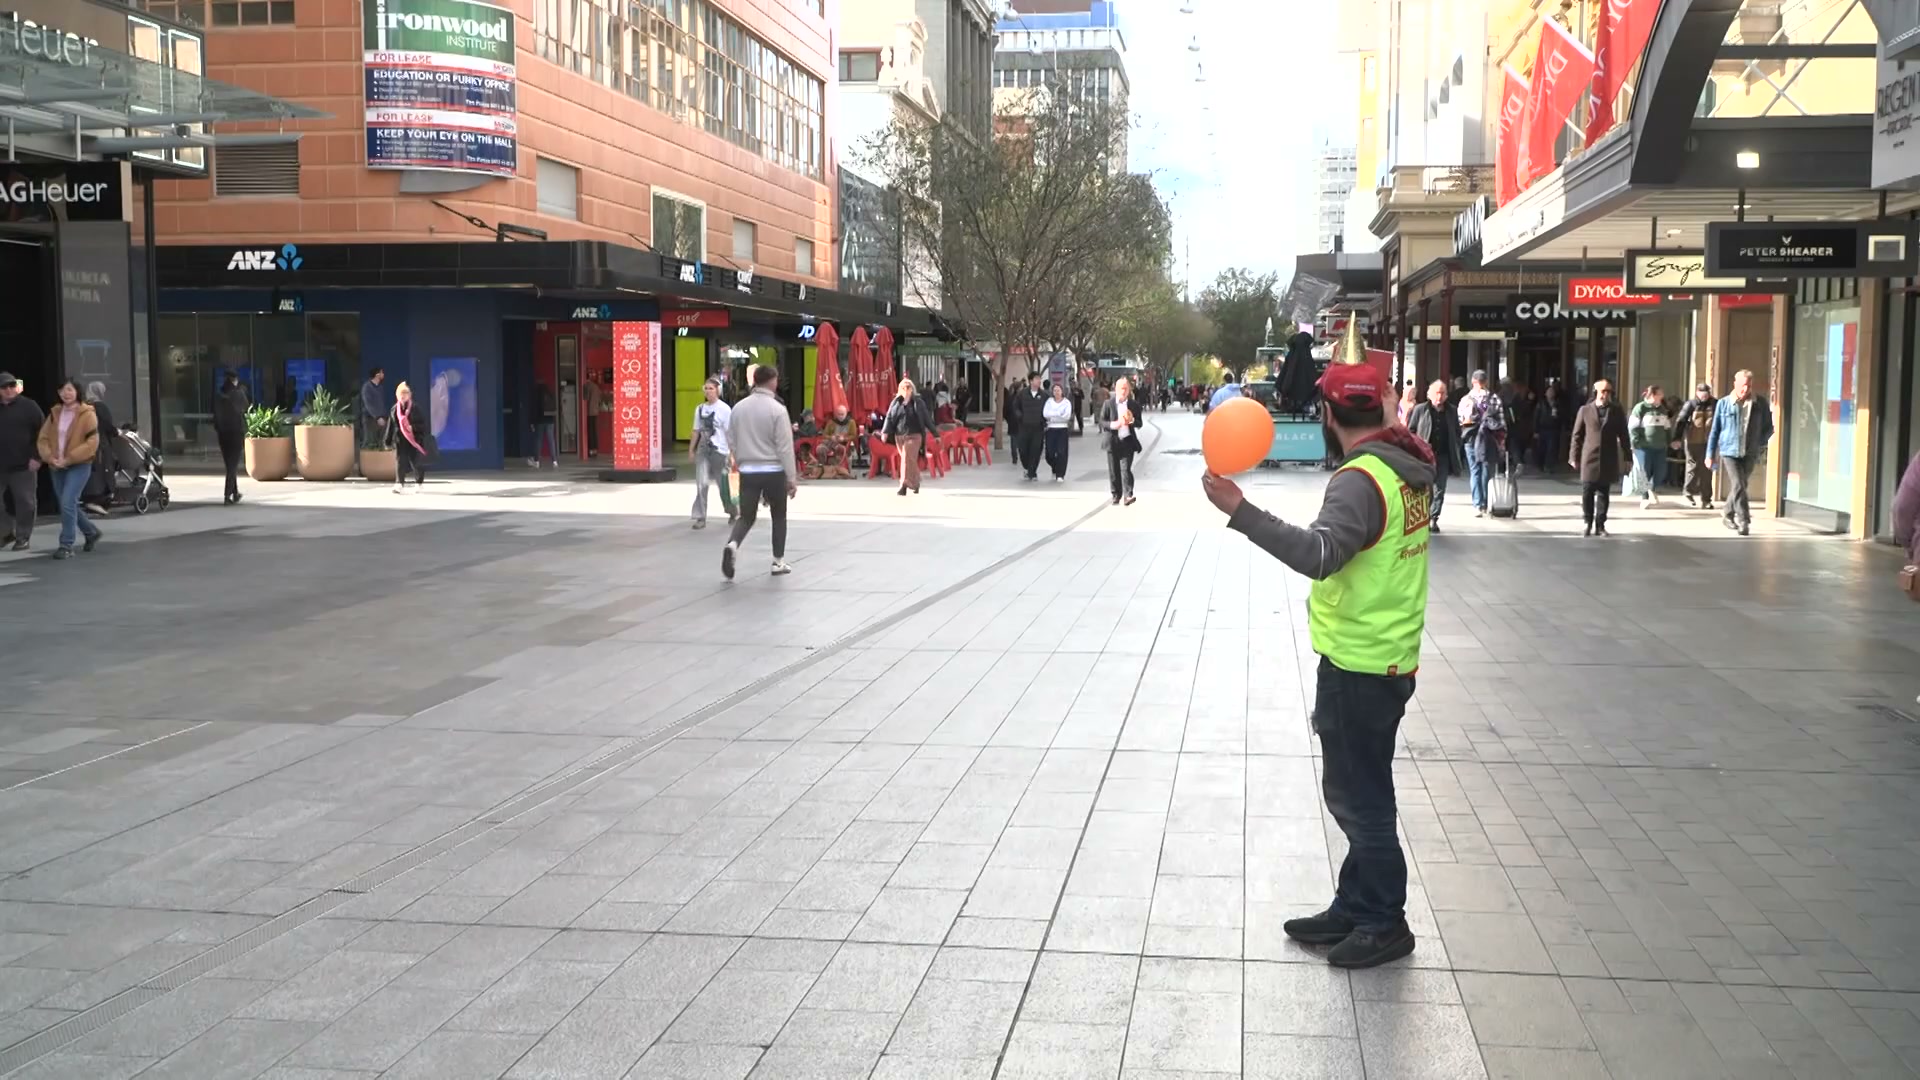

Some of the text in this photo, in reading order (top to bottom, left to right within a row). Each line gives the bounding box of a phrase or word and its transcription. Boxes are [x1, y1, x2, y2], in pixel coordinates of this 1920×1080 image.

[376, 3, 508, 42] ironwood
[446, 35, 497, 53] INSTITUTE
[374, 53, 432, 64] FOR LEASE
[374, 70, 433, 81] EDUCATION
[436, 73, 451, 83] OR
[453, 75, 483, 87] FUNKY
[484, 78, 511, 92] OFFICE
[376, 113, 398, 121] FOR
[377, 129, 513, 148] KEEP YOUR EYE ON THE MALL
[1740, 247, 1834, 256] PETER SHEARER
[227, 251, 276, 270] ANZ
[279, 299, 295, 310] ANZ
[572, 307, 598, 318] ANZ
[798, 325, 815, 338] JD
